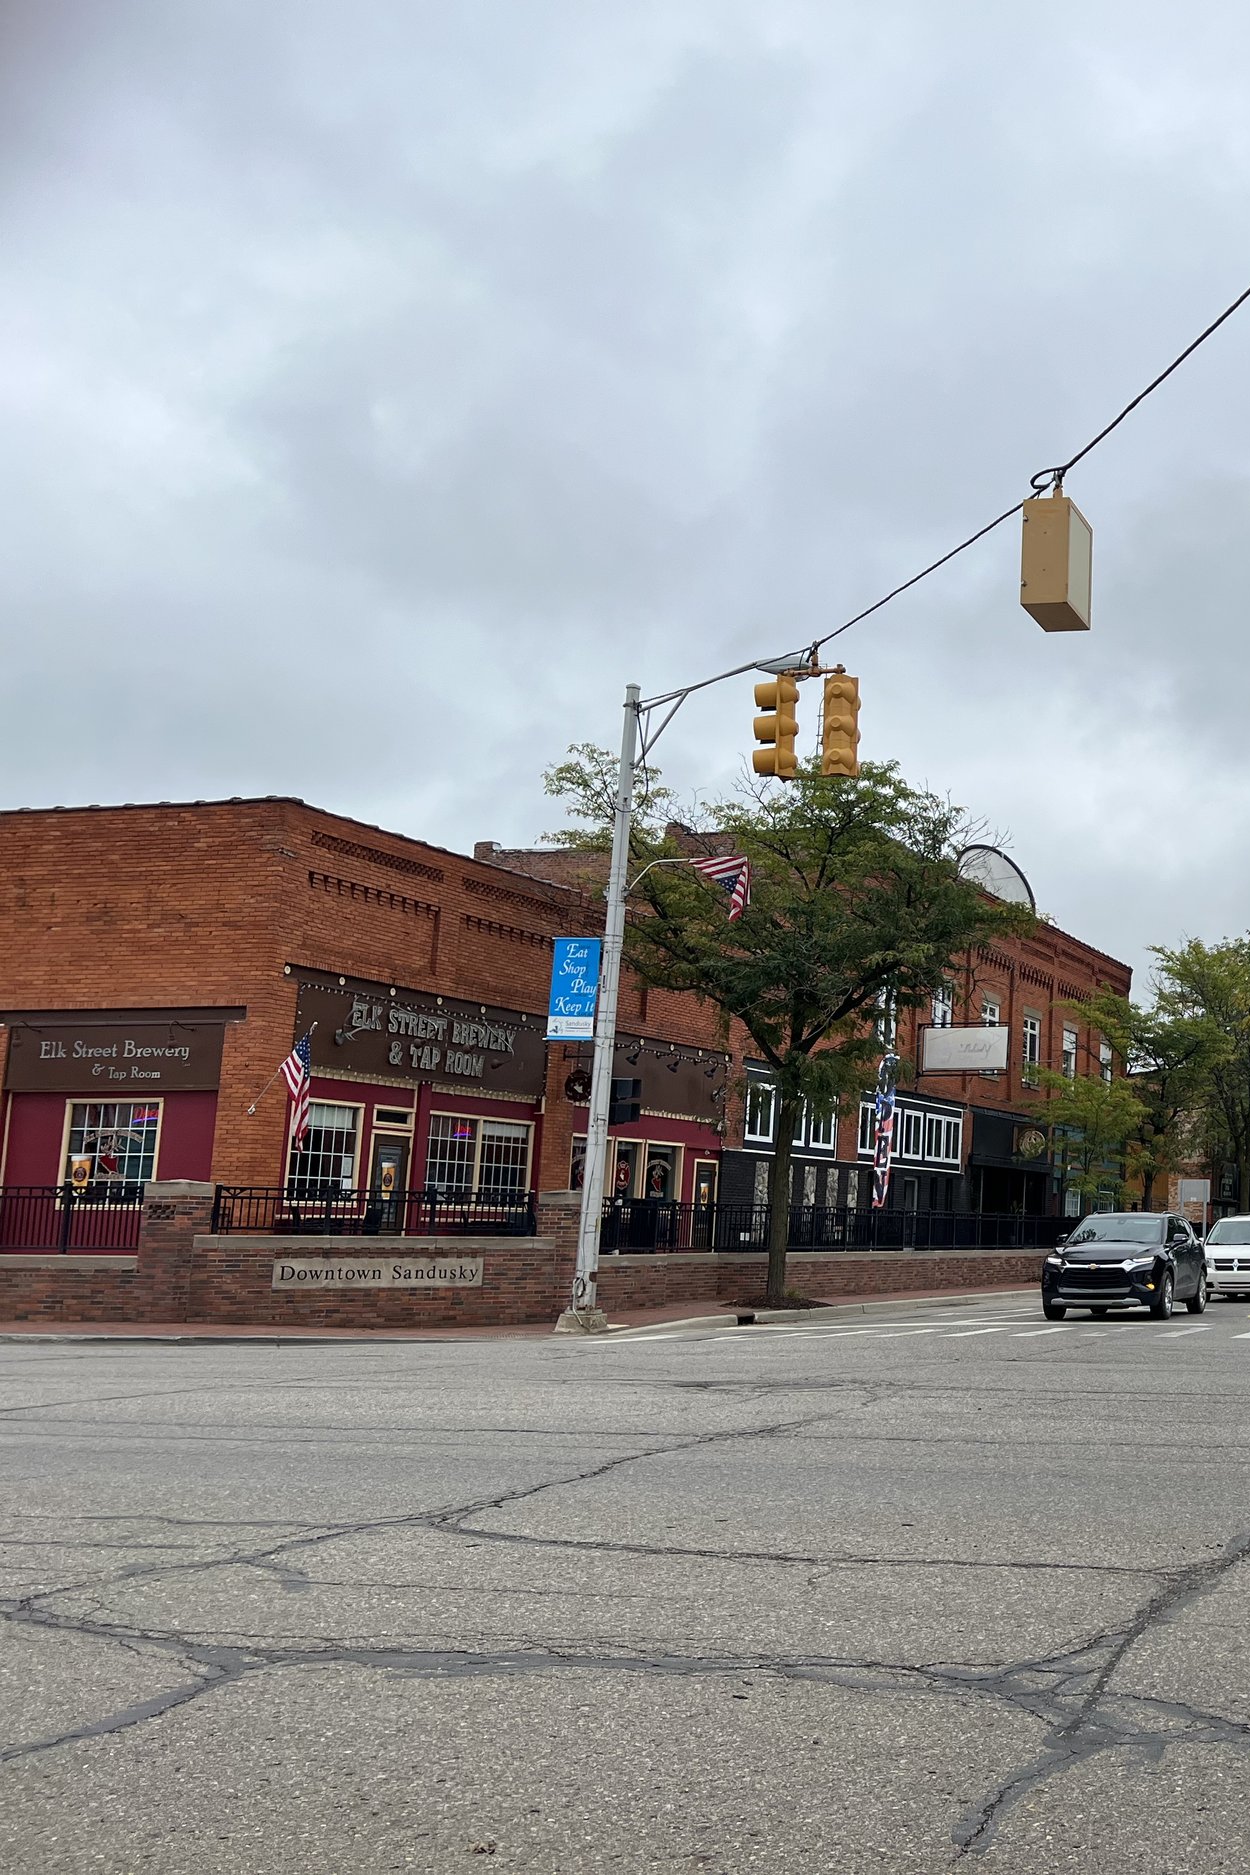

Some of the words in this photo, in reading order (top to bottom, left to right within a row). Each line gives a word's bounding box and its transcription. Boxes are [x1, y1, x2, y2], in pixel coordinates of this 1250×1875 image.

[566, 943, 588, 958] Eat
[559, 959, 586, 978] Shop
[570, 978, 597, 998] Play
[554, 996, 582, 1015] Keep
[585, 1001, 595, 1012] It
[352, 1002, 383, 1030] ELK
[388, 1008, 448, 1041] STREET
[452, 1021, 516, 1052] BREWERY
[39, 1041, 67, 1058] Elk
[72, 1041, 118, 1058] Street
[123, 1040, 190, 1060] Brewery
[389, 1040, 403, 1066] &
[410, 1043, 441, 1071] TAP
[445, 1050, 486, 1078] ROOM
[108, 1066, 127, 1081] Tap
[130, 1066, 161, 1079] Room
[279, 1265, 382, 1281] Downtown
[392, 1264, 479, 1282] Sandusky
